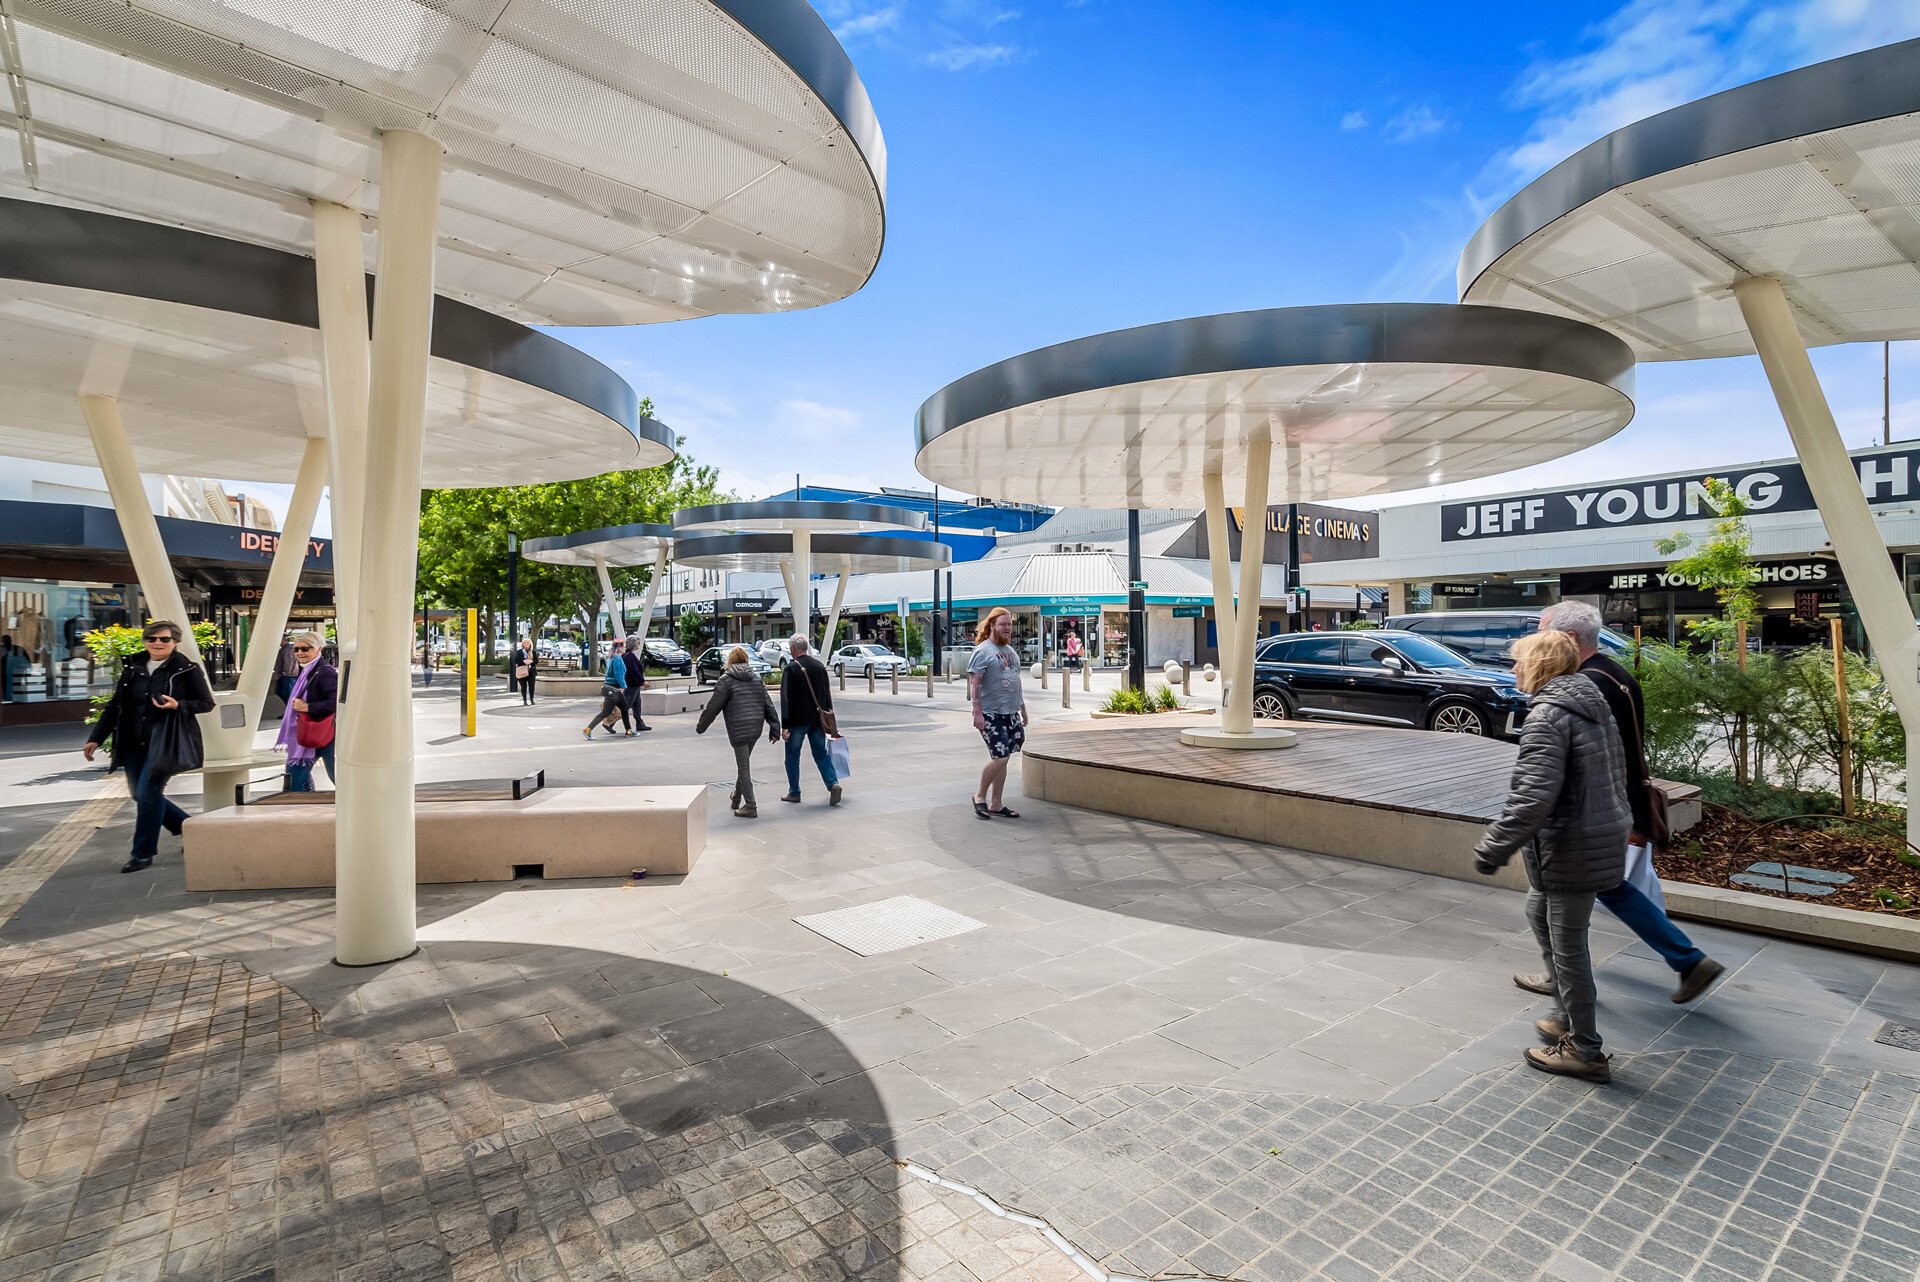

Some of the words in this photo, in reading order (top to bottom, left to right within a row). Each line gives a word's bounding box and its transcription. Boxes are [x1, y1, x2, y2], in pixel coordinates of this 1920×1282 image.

[1458, 499, 1545, 537] JEFF
[1565, 472, 1783, 525] YOUNG
[1267, 511, 1310, 535] ILLGE
[1315, 518, 1370, 542] CINEMAS
[1609, 574, 1648, 590] JEFF
[1751, 564, 1828, 583] SHOES
[241, 589, 305, 600] IDEY
